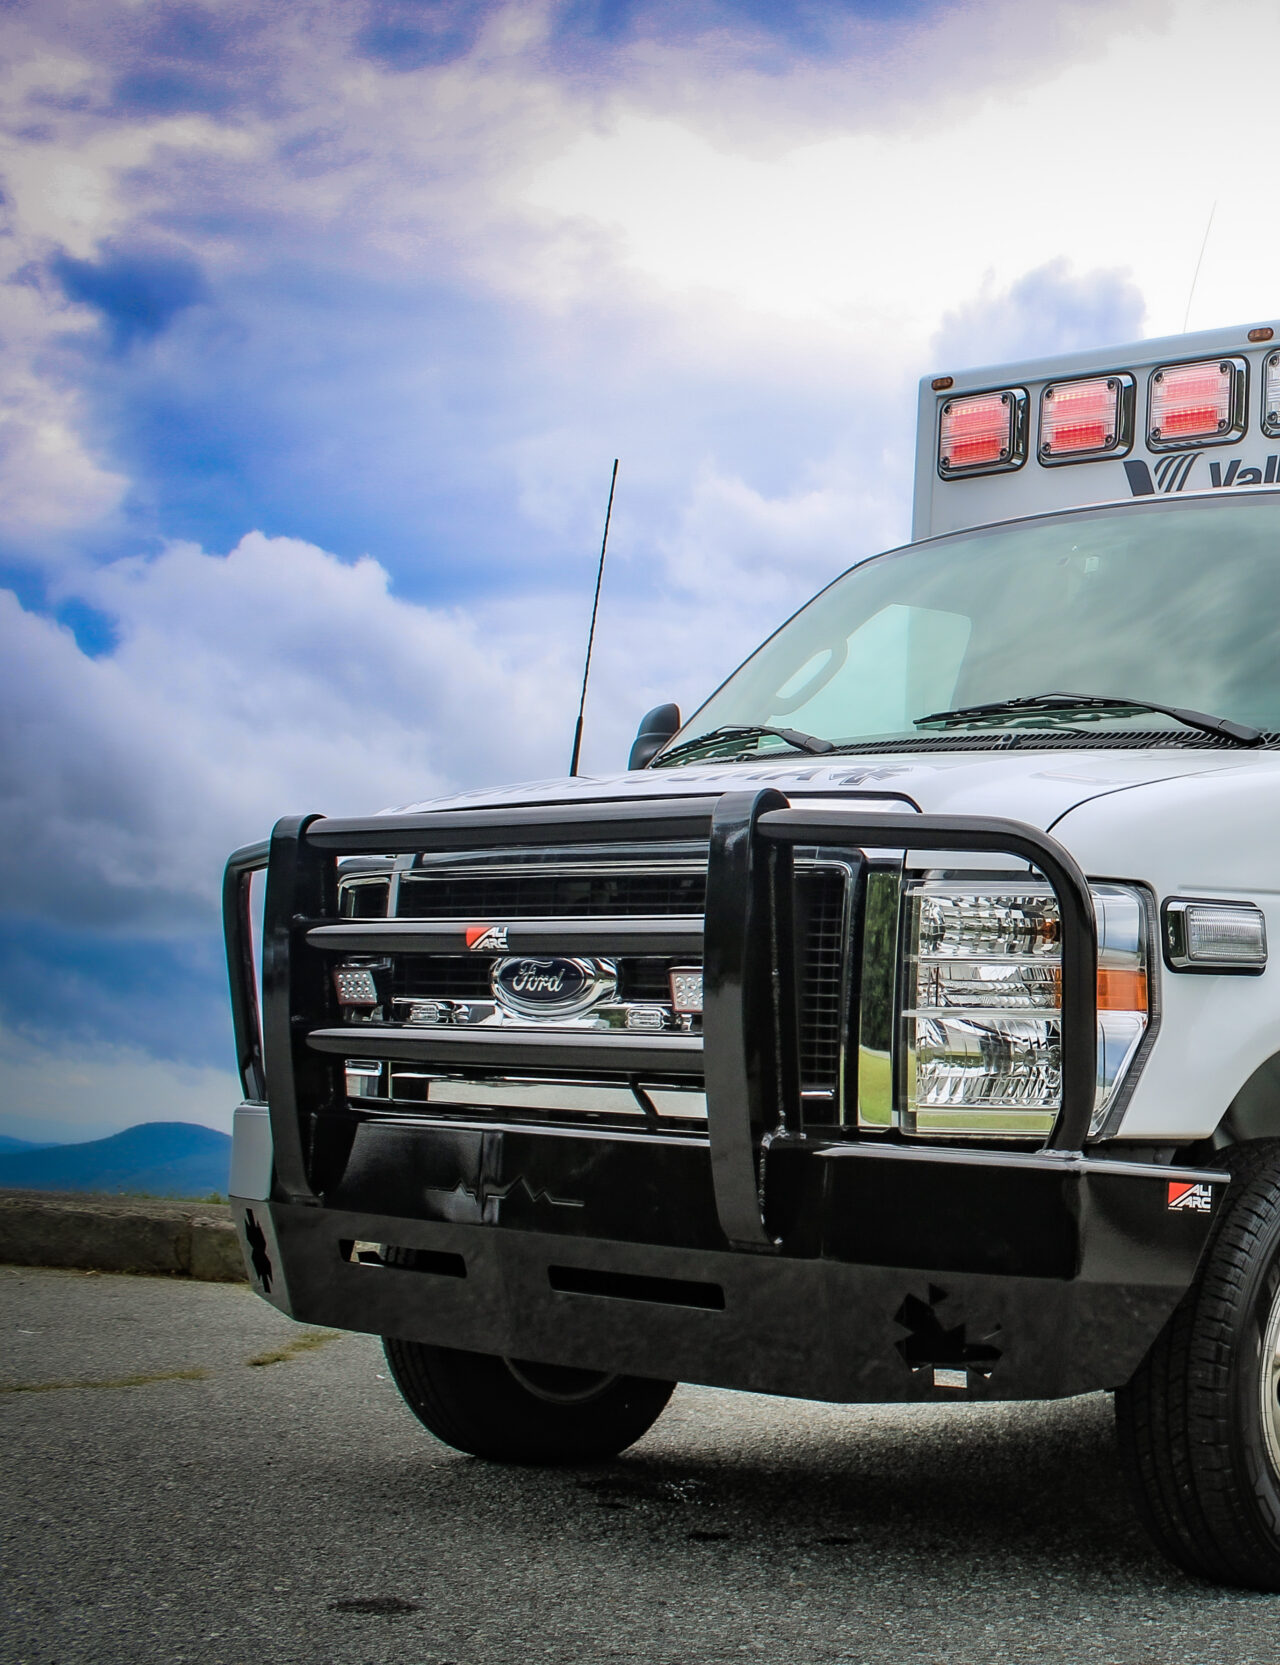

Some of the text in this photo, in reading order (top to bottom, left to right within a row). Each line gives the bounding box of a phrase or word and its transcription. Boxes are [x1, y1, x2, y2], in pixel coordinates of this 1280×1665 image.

[477, 938, 509, 949] ARC
[512, 960, 566, 992] Ford
[1177, 1196, 1211, 1209] ARC
